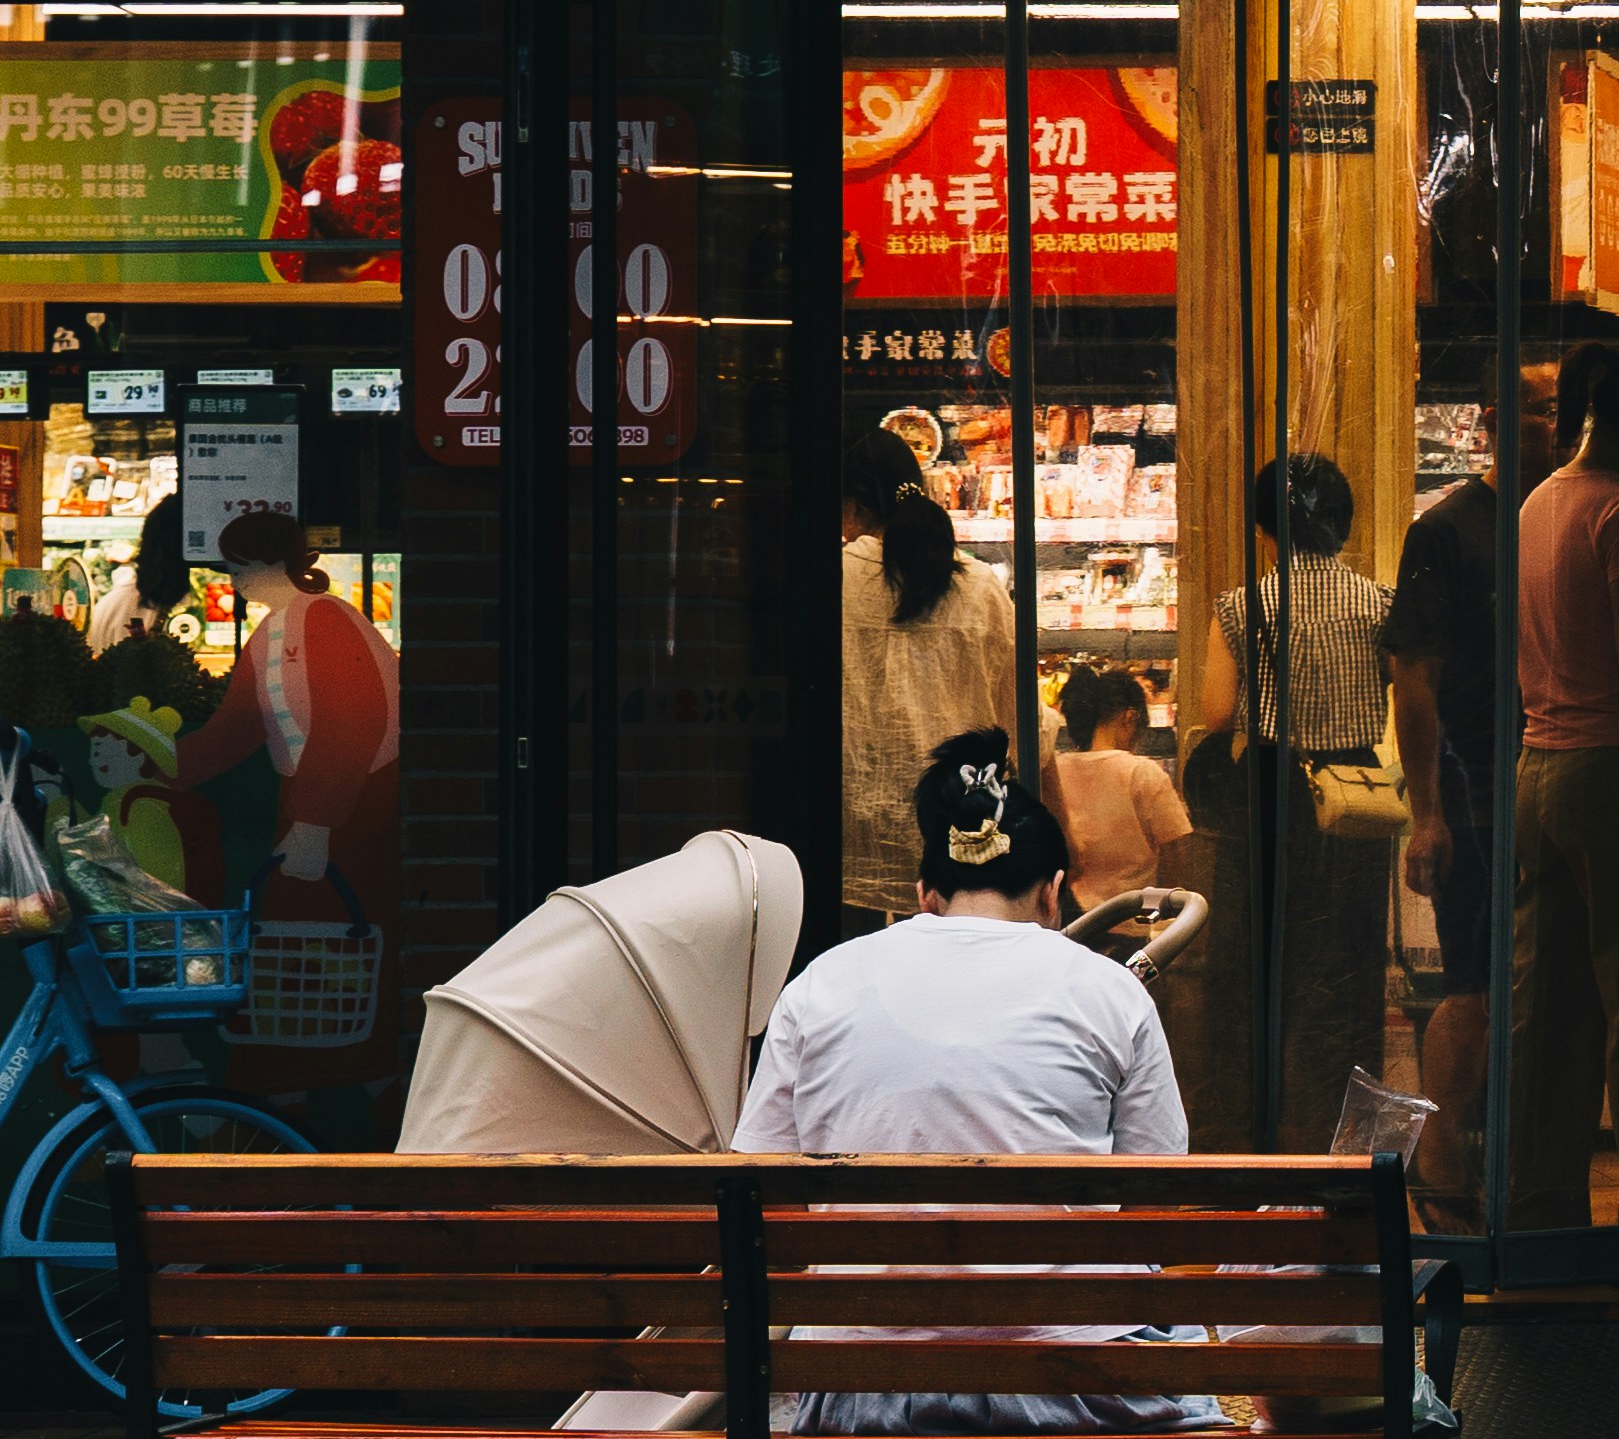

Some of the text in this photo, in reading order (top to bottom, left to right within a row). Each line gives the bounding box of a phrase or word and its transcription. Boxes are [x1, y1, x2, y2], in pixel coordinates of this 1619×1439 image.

[1302, 88, 1367, 106] 小心地滑
[0, 93, 258, 143] 丹东99草莓
[458, 121, 658, 177] SUIVEN
[124, 385, 143, 399] 29
[368, 384, 387, 398] 69
